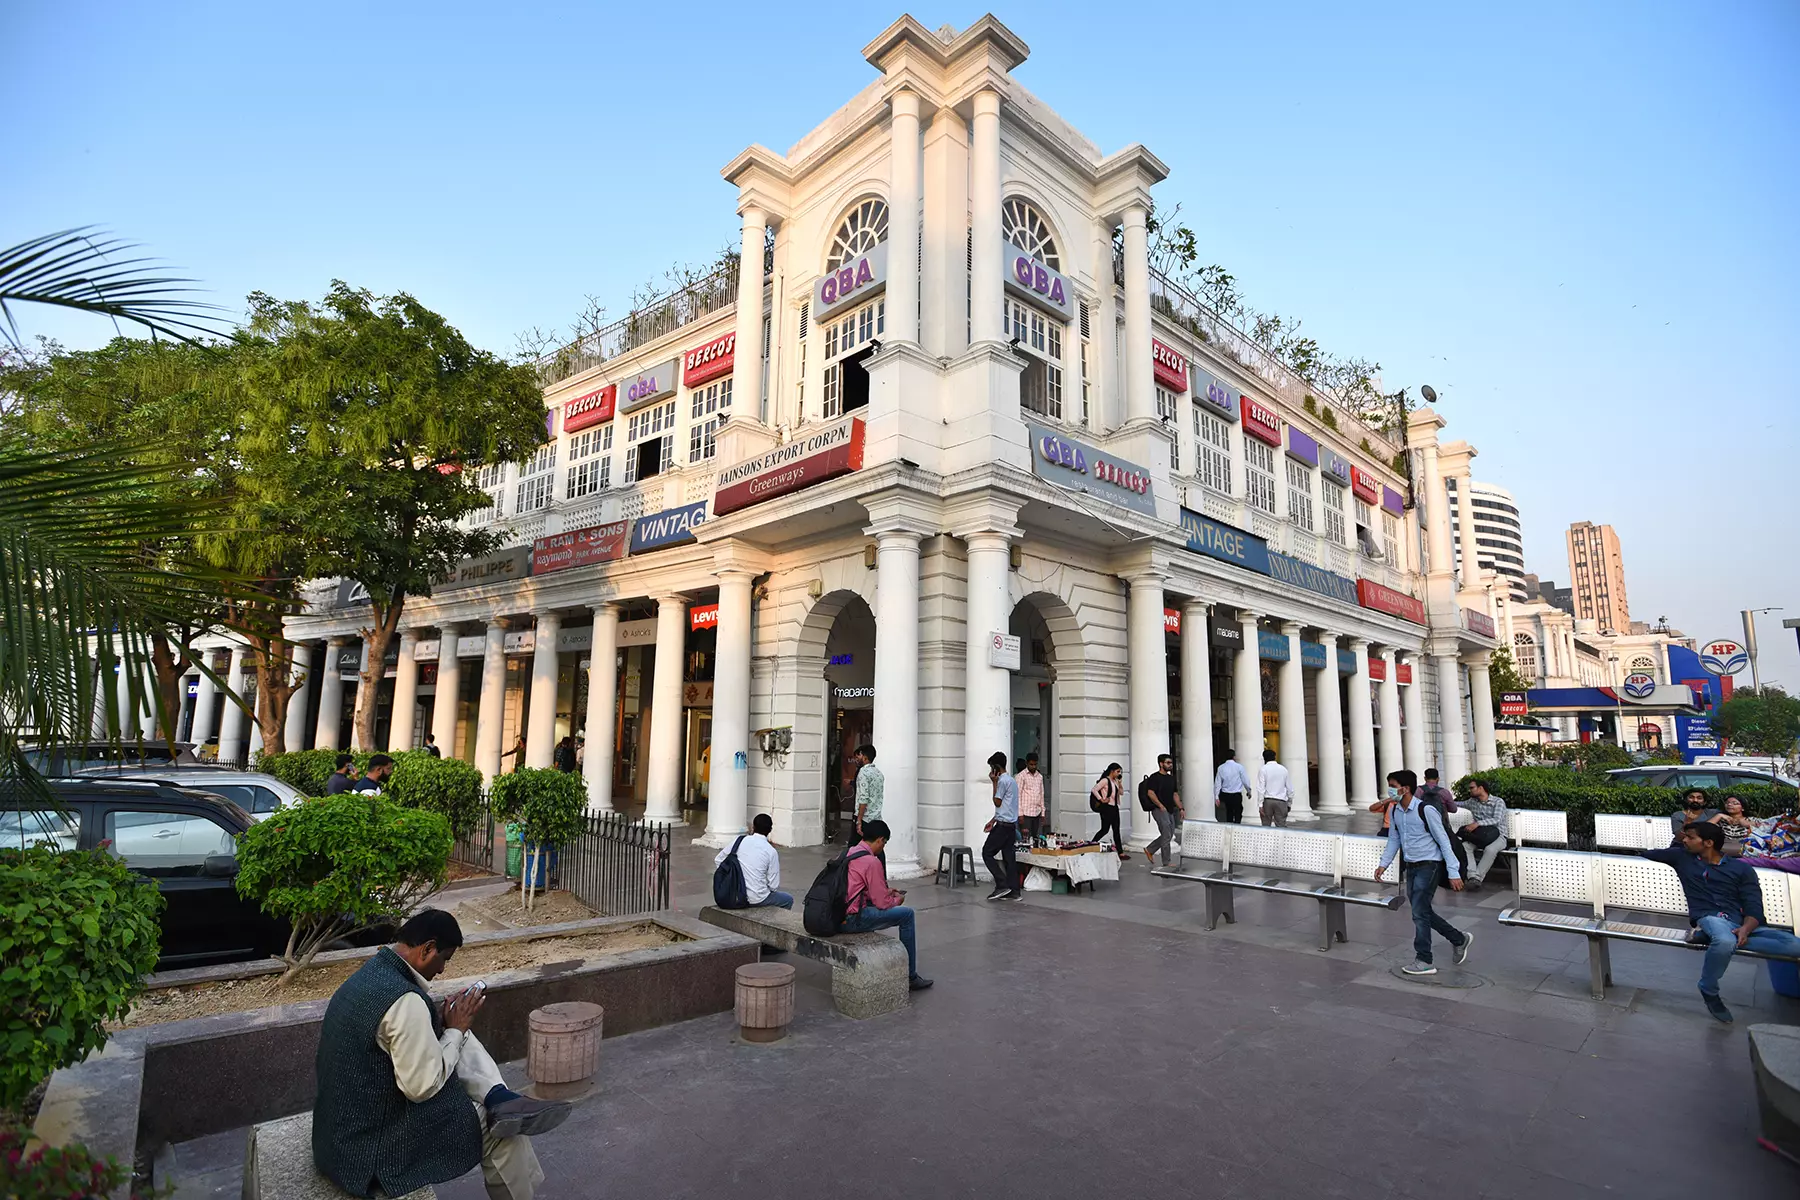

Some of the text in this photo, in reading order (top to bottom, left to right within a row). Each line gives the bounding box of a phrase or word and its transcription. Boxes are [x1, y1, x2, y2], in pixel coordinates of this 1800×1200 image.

[687, 335, 735, 371] BERCO'S
[1152, 343, 1183, 374] ERCO'S
[566, 391, 604, 419] BERCO'S
[1251, 404, 1279, 432] BERCO'S
[718, 425, 849, 487] JAINSONS EXPORT CORPN.
[749, 466, 805, 494] Greenways
[550, 534, 575, 548] RAM
[578, 532, 587, 543] &
[590, 523, 625, 540] SONS
[641, 507, 705, 543] VINTAG
[461, 559, 515, 581] PHILIPPE
[1267, 553, 1305, 585] INDIAN
[1305, 569, 1330, 593] ARTS
[1711, 644, 1737, 655] HP
[1630, 676, 1648, 684] HP
[1503, 694, 1523, 702] QBA
